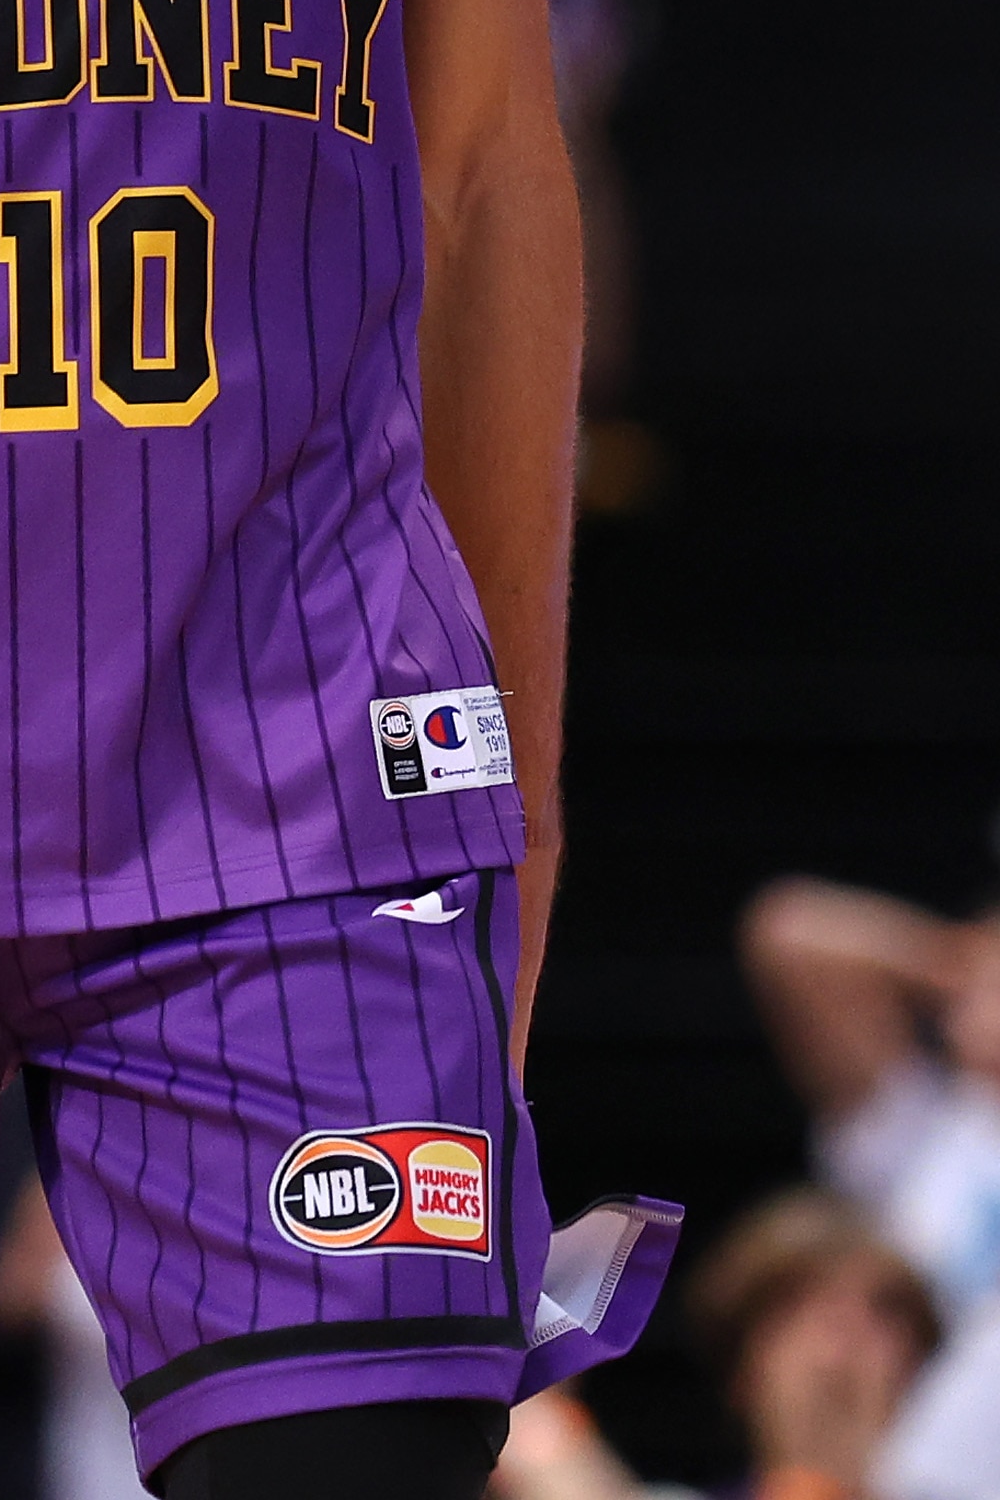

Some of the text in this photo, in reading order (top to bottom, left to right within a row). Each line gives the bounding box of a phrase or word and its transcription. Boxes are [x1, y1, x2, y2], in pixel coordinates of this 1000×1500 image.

[385, 714, 411, 735] NBL
[415, 1168, 479, 1192] HUNGRY
[303, 1165, 376, 1220] NBL
